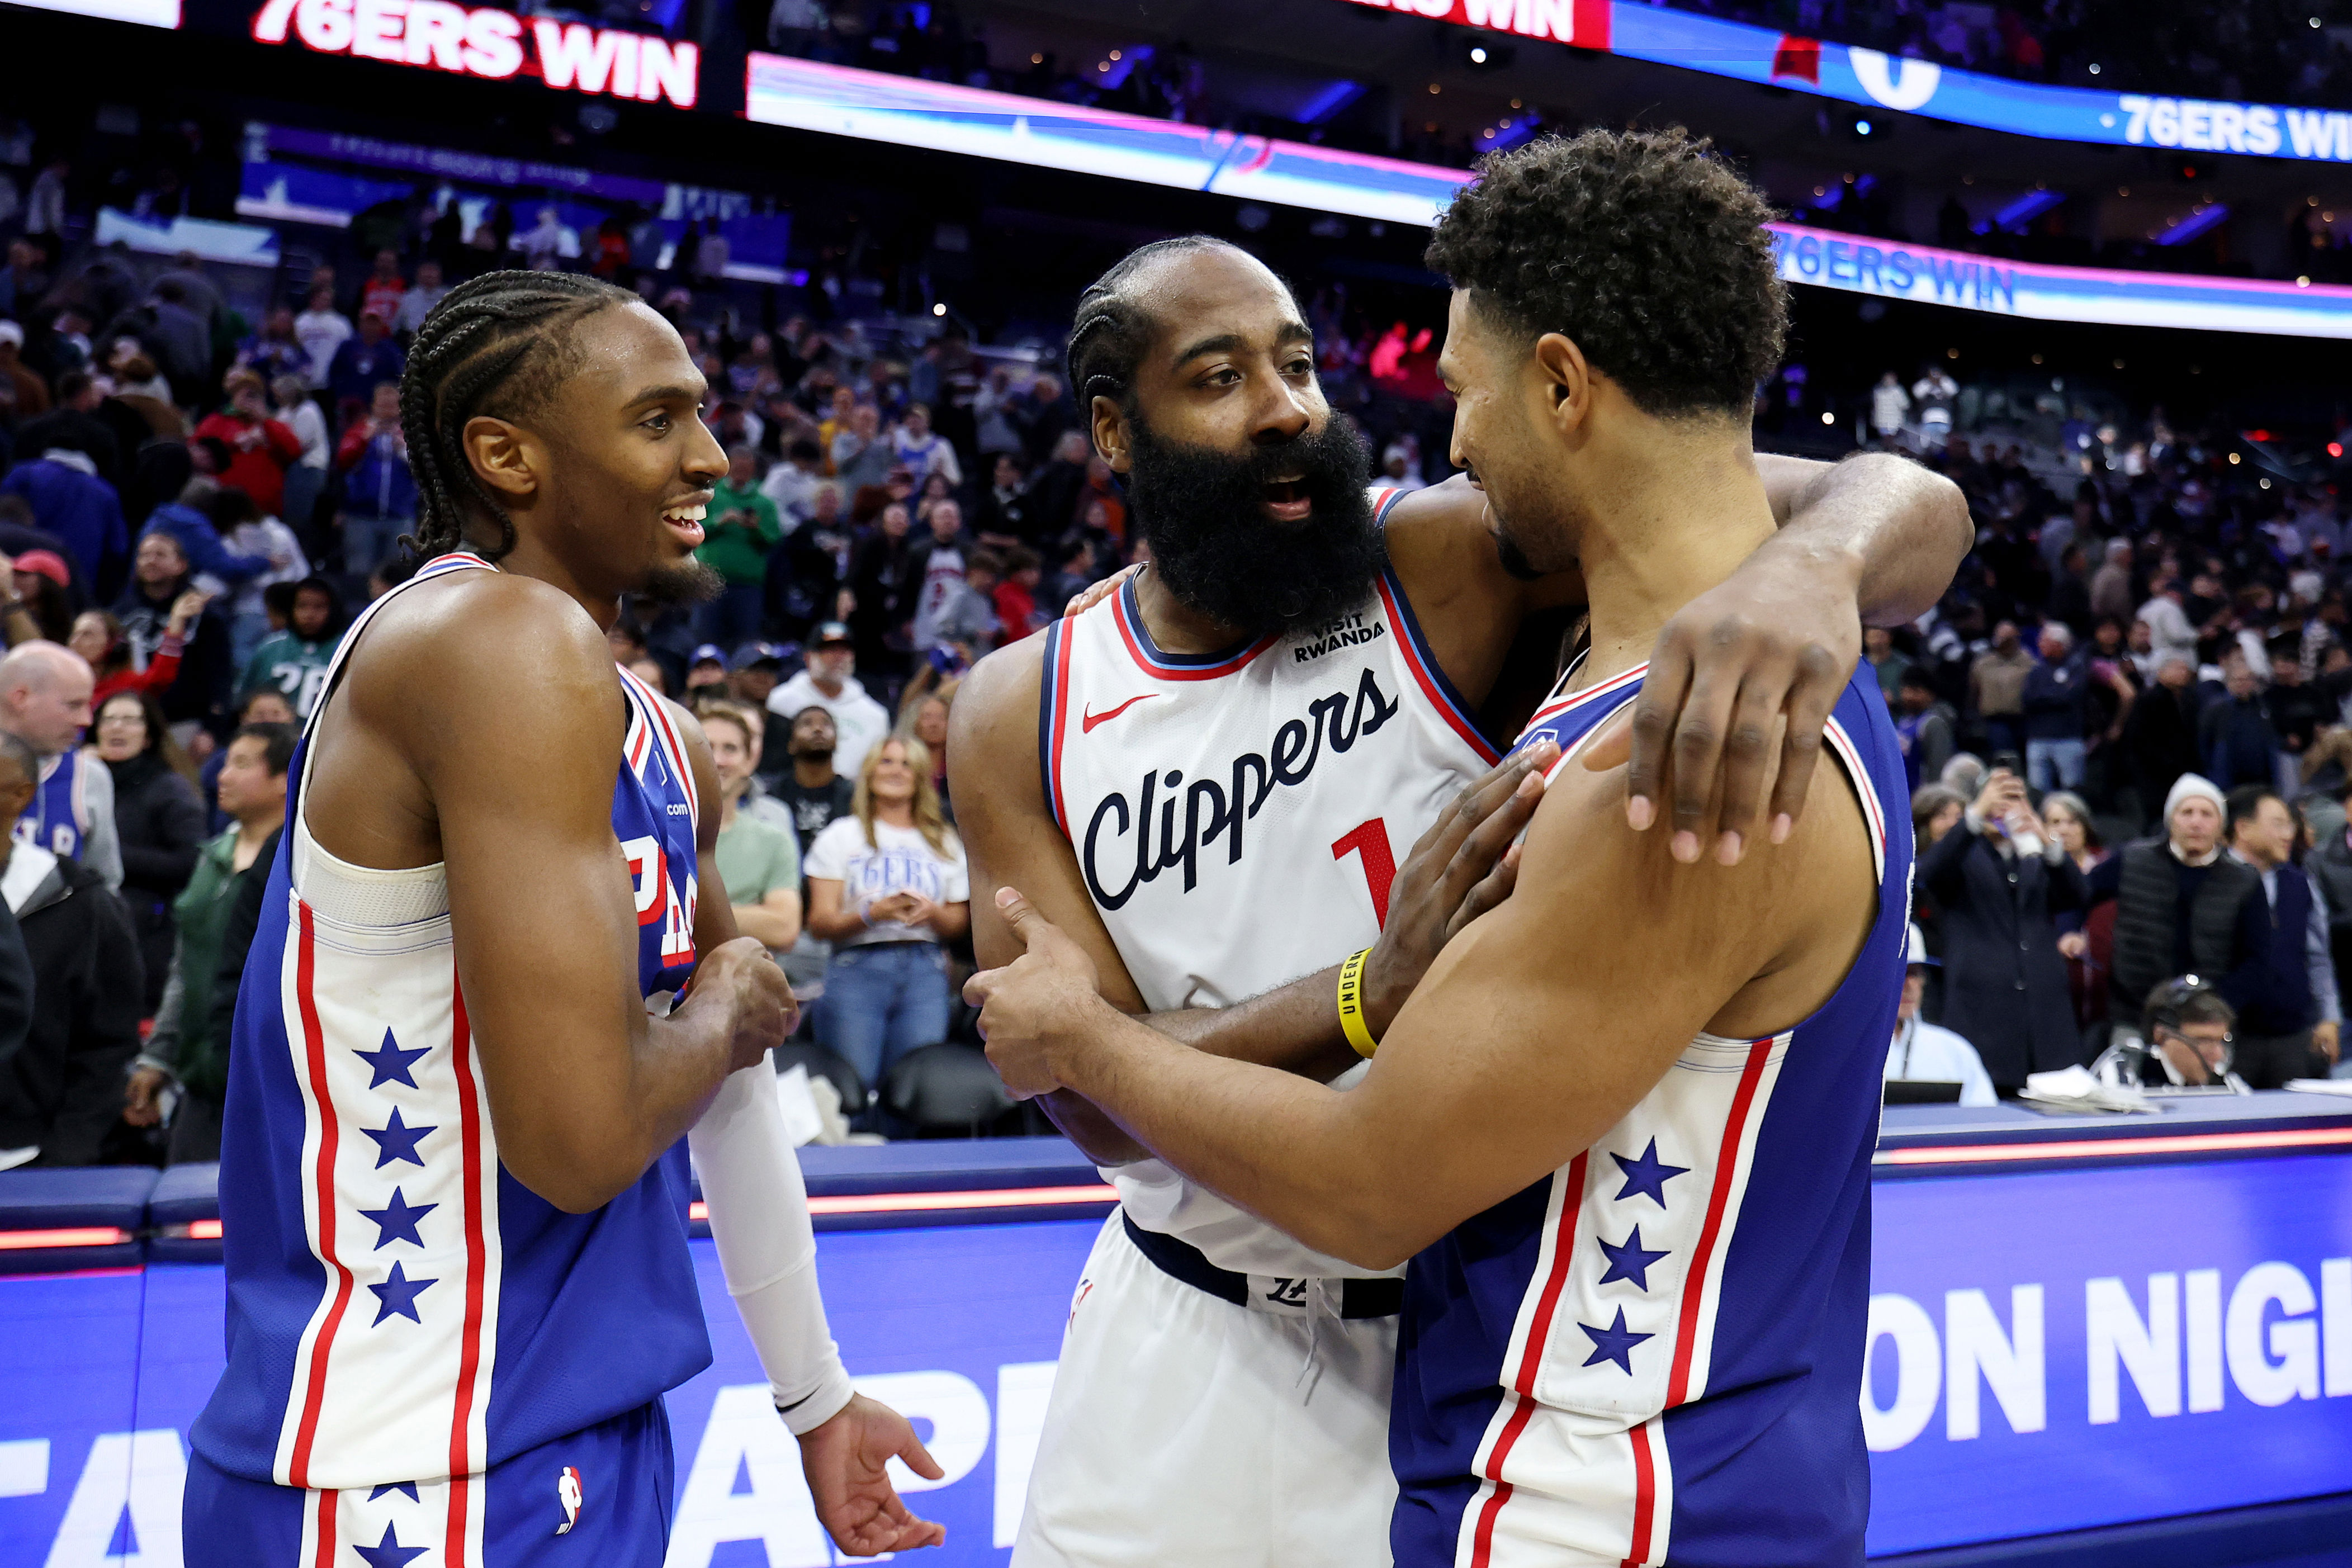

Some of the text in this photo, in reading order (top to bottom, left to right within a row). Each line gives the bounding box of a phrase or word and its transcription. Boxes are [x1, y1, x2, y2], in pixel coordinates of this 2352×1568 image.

[533, 18, 699, 108] WIN
[2119, 94, 2352, 161] 76ERS WI
[1781, 232, 2014, 306] 6ERS WIN
[1294, 622, 1385, 662] RWANDA
[1083, 667, 1399, 911] Clippers
[1332, 817, 1397, 934] 1
